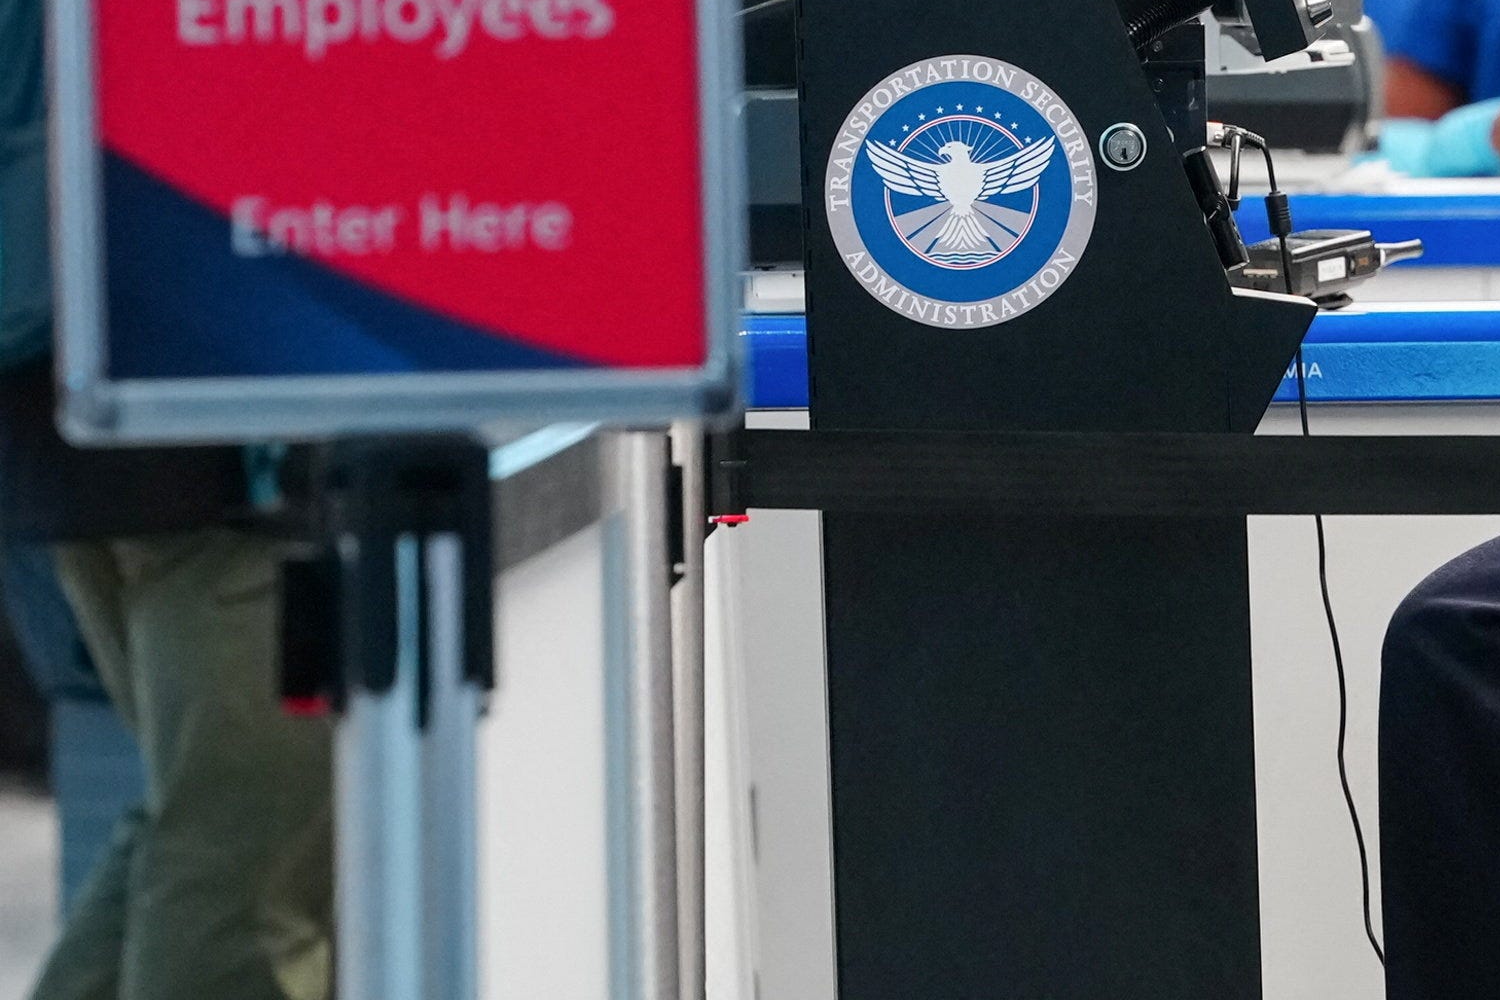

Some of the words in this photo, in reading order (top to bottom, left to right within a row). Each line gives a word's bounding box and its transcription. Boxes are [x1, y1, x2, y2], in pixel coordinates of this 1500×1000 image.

[830, 59, 1017, 212] TRANSPORTATION
[1020, 80, 1093, 207] SECURITY
[231, 196, 396, 257] Enter
[420, 199, 571, 250] Here
[846, 247, 1077, 326] ADMINISTRATION
